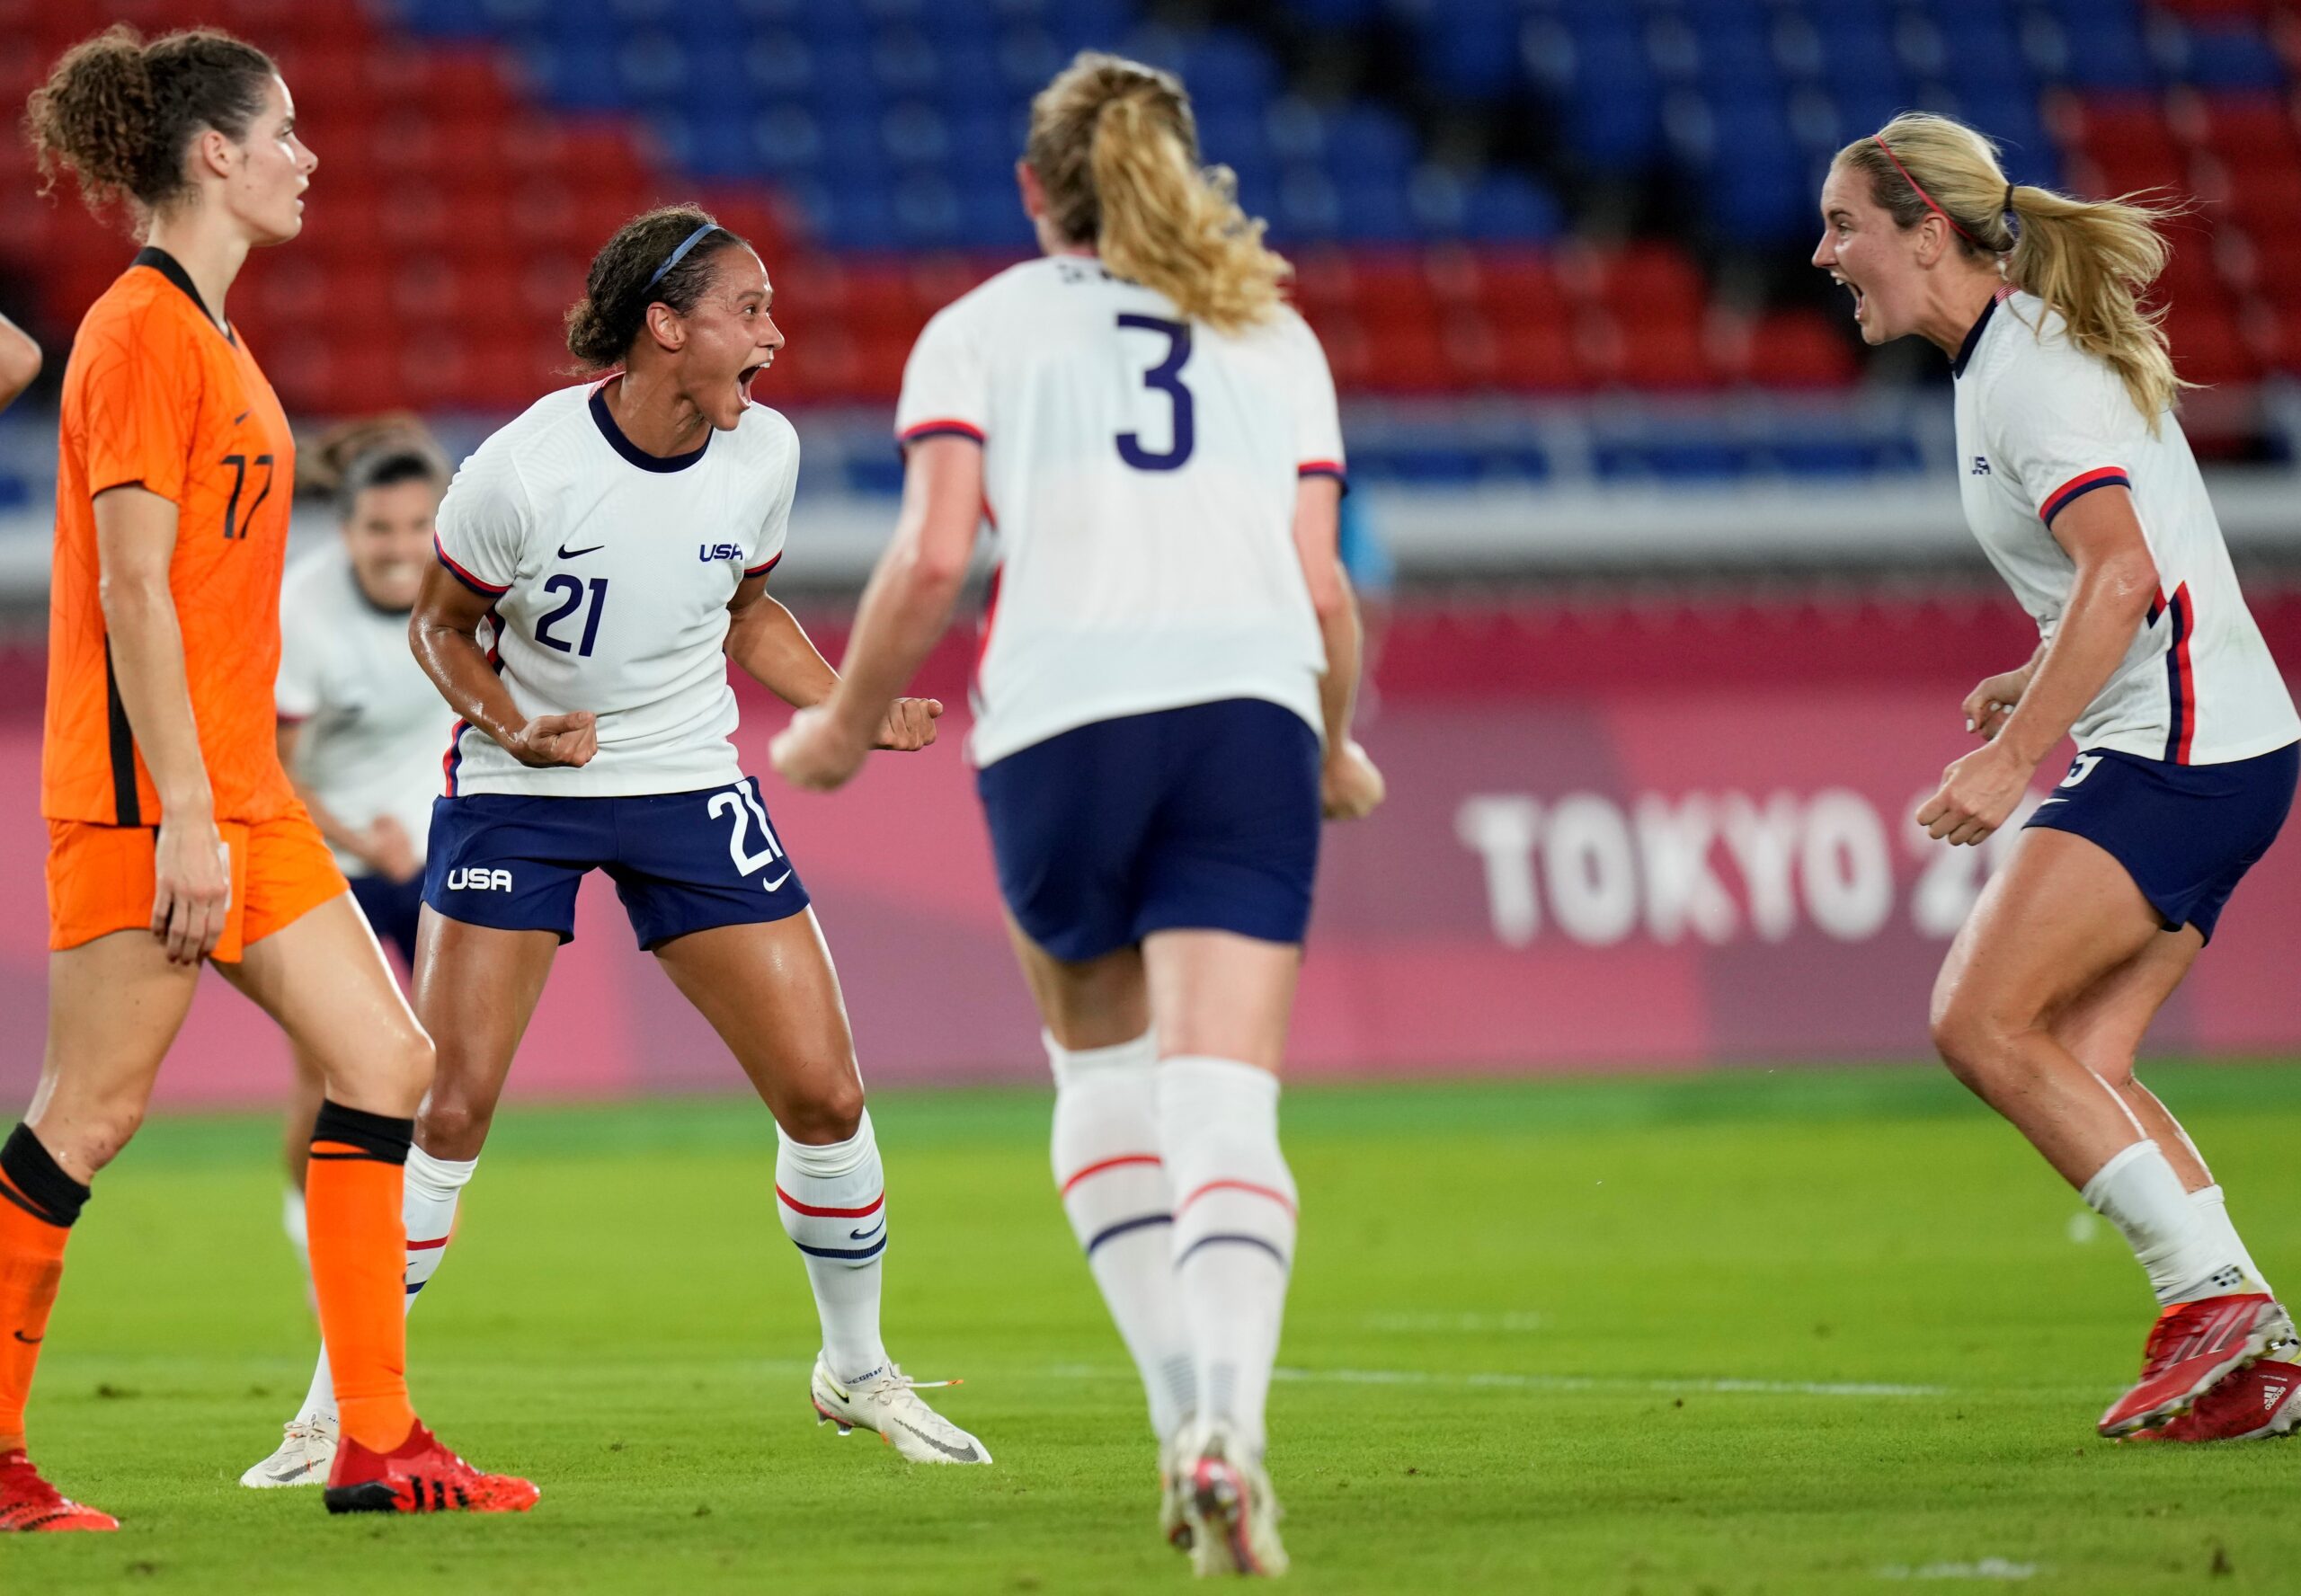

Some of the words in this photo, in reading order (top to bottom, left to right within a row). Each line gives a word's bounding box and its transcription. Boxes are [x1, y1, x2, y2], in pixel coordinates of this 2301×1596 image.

[1115, 313, 1195, 472] 3
[699, 543, 743, 563] USA
[535, 573, 609, 658] 21
[707, 779, 784, 877] 21
[1458, 789, 1890, 946] TOKYO
[447, 867, 512, 892] USA
